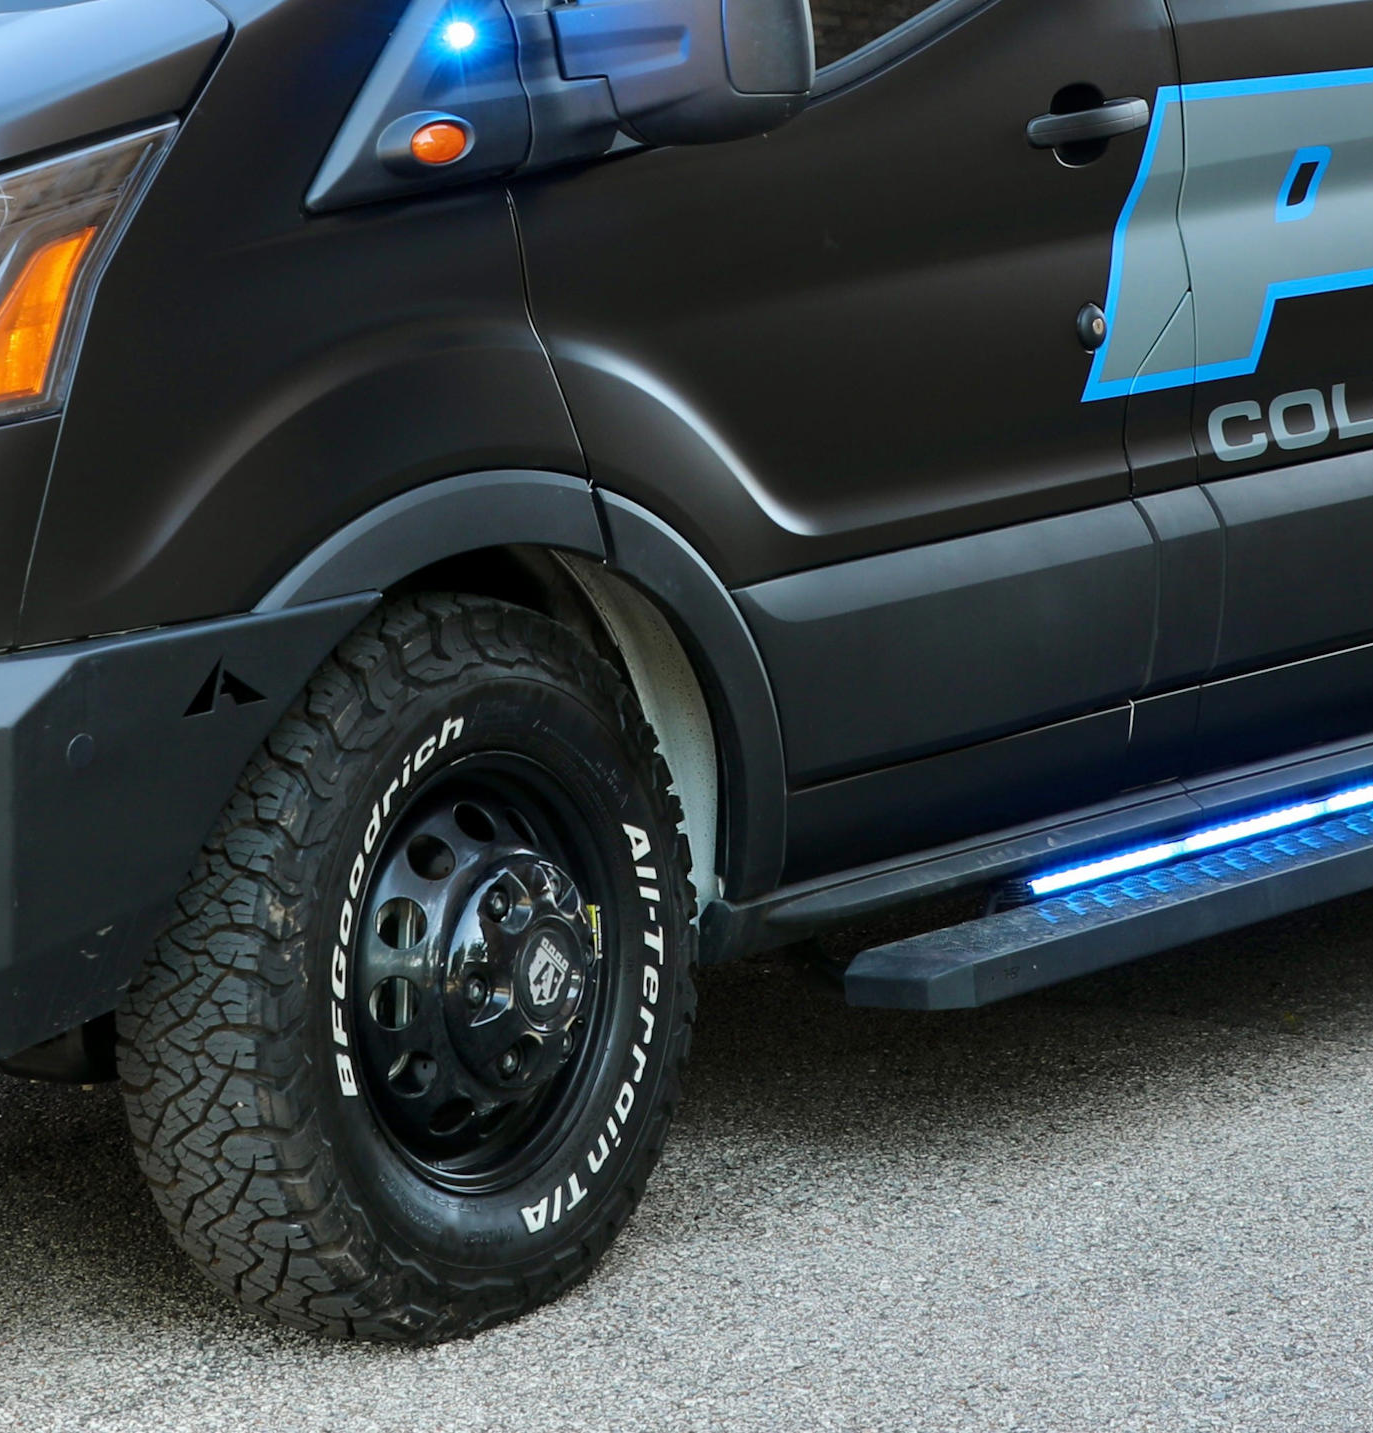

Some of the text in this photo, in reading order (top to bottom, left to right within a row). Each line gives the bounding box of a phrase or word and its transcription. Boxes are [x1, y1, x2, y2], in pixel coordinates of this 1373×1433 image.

[330, 714, 465, 1098] BFGoodrich
[520, 822, 666, 1235] All-Terrain T/A
